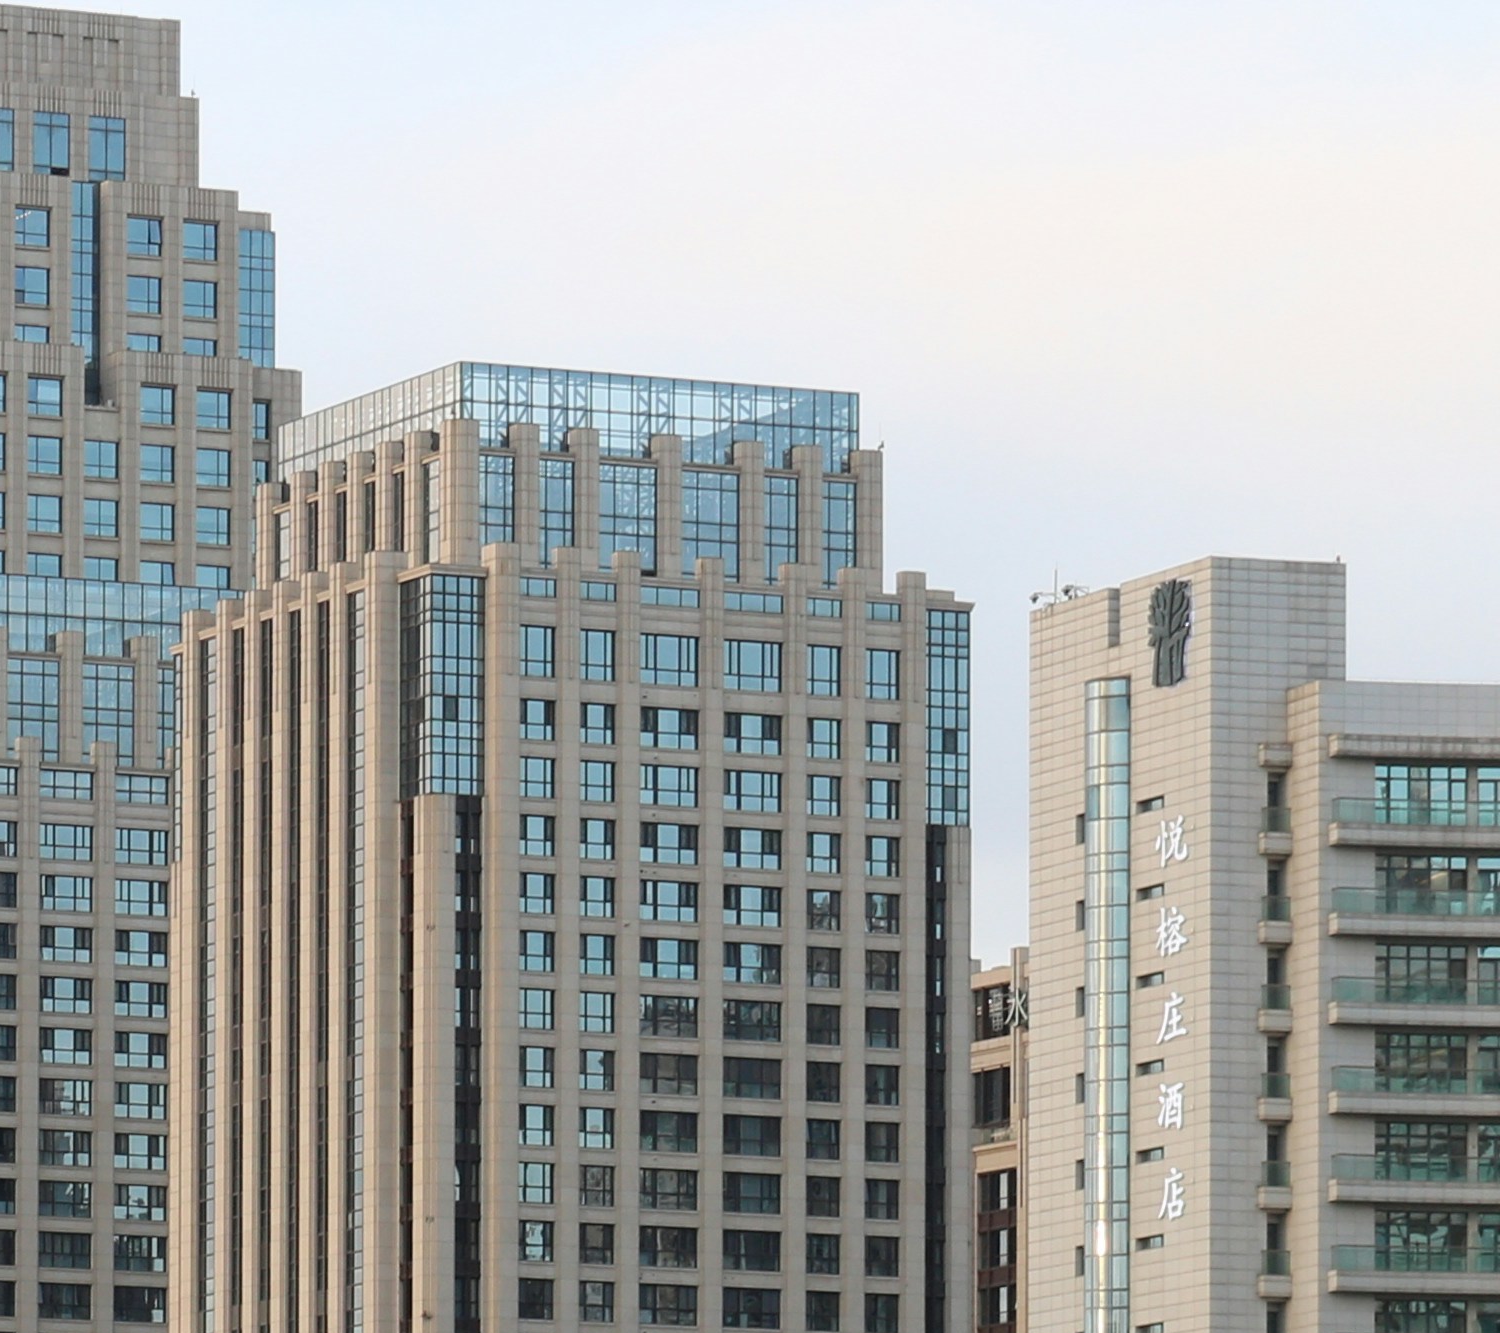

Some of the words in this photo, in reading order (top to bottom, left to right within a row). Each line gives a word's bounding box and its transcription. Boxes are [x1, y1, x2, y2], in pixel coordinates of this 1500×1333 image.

[1154, 814, 1190, 1222] 悦榕庄酒店
